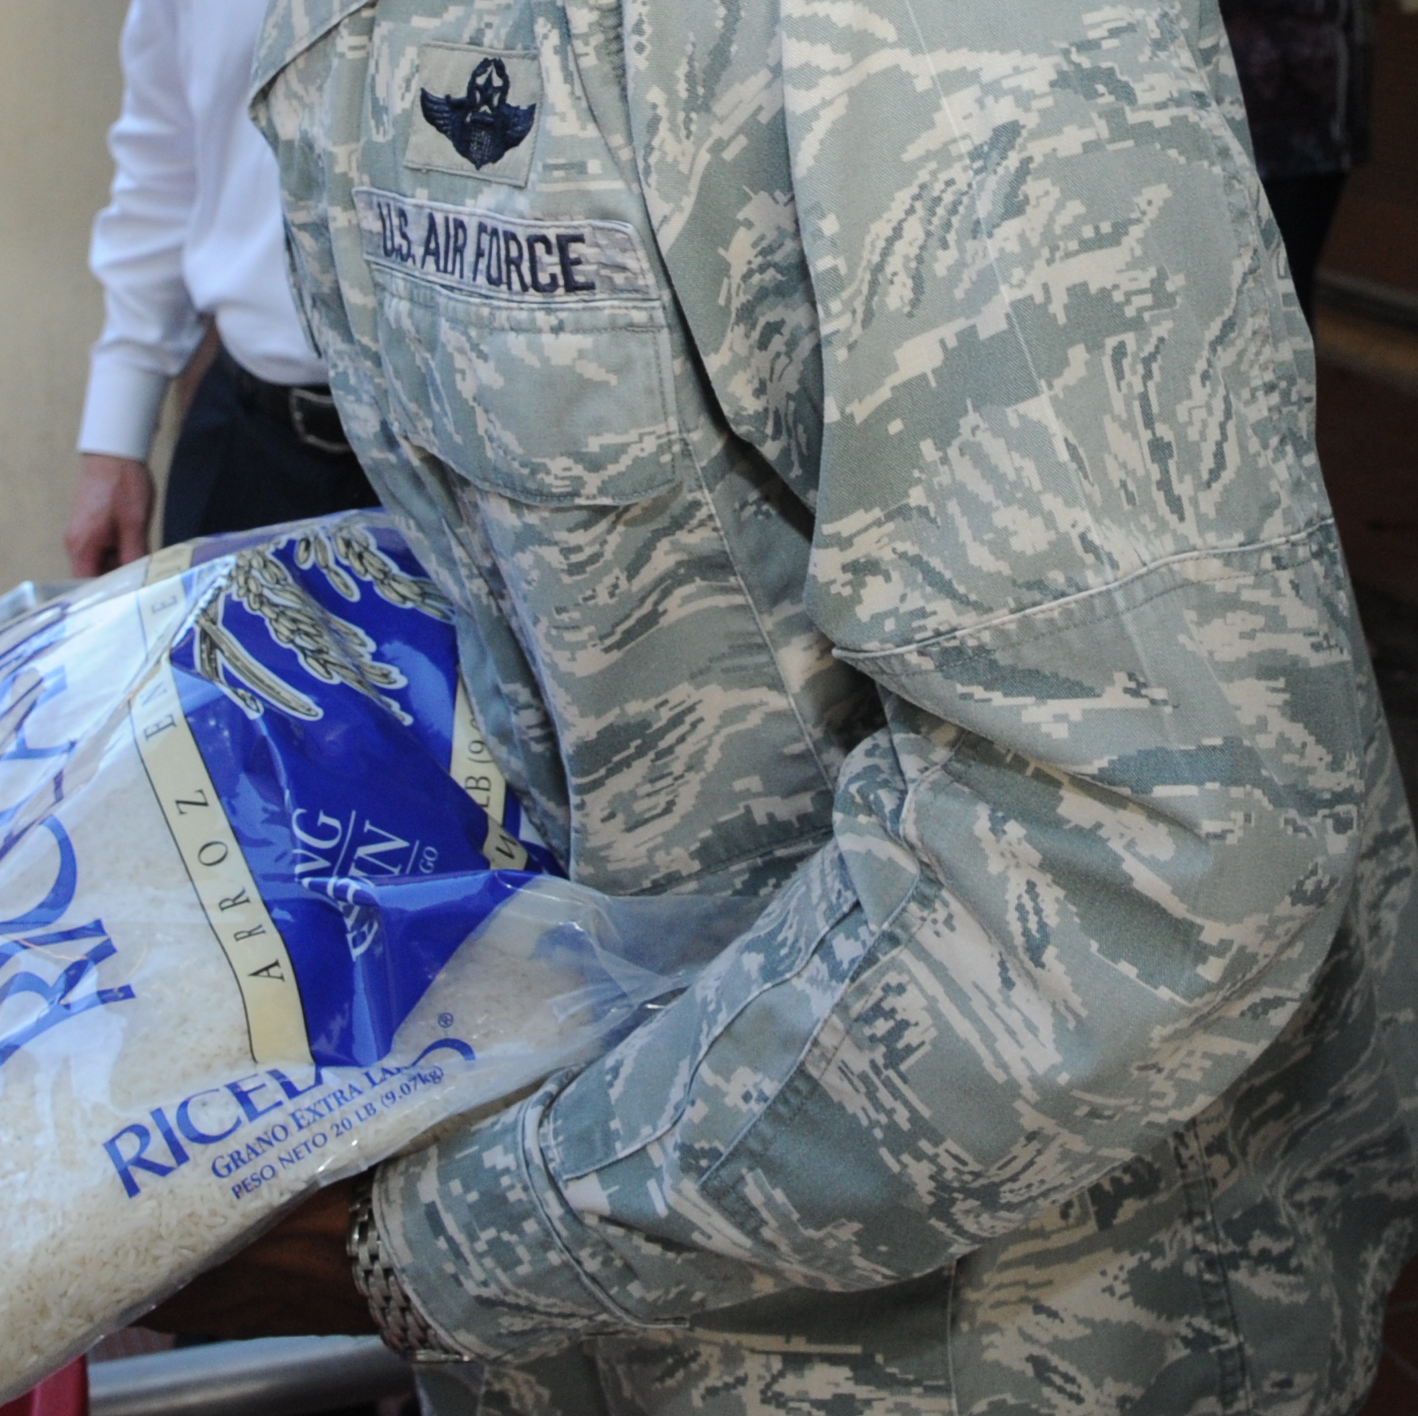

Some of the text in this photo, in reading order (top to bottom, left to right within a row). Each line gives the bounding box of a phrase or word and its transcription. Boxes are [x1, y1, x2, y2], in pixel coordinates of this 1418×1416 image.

[377, 201, 596, 293] U.S. AIR FORCE
[175, 788, 285, 983] ARROZ
[211, 1125, 289, 1179] GRANO
[291, 1082, 365, 1131] EXTRA
[231, 1164, 276, 1200] PESO
[280, 1132, 328, 1170] NETO
[330, 1115, 354, 1139] 20
[356, 1101, 378, 1124] LB
